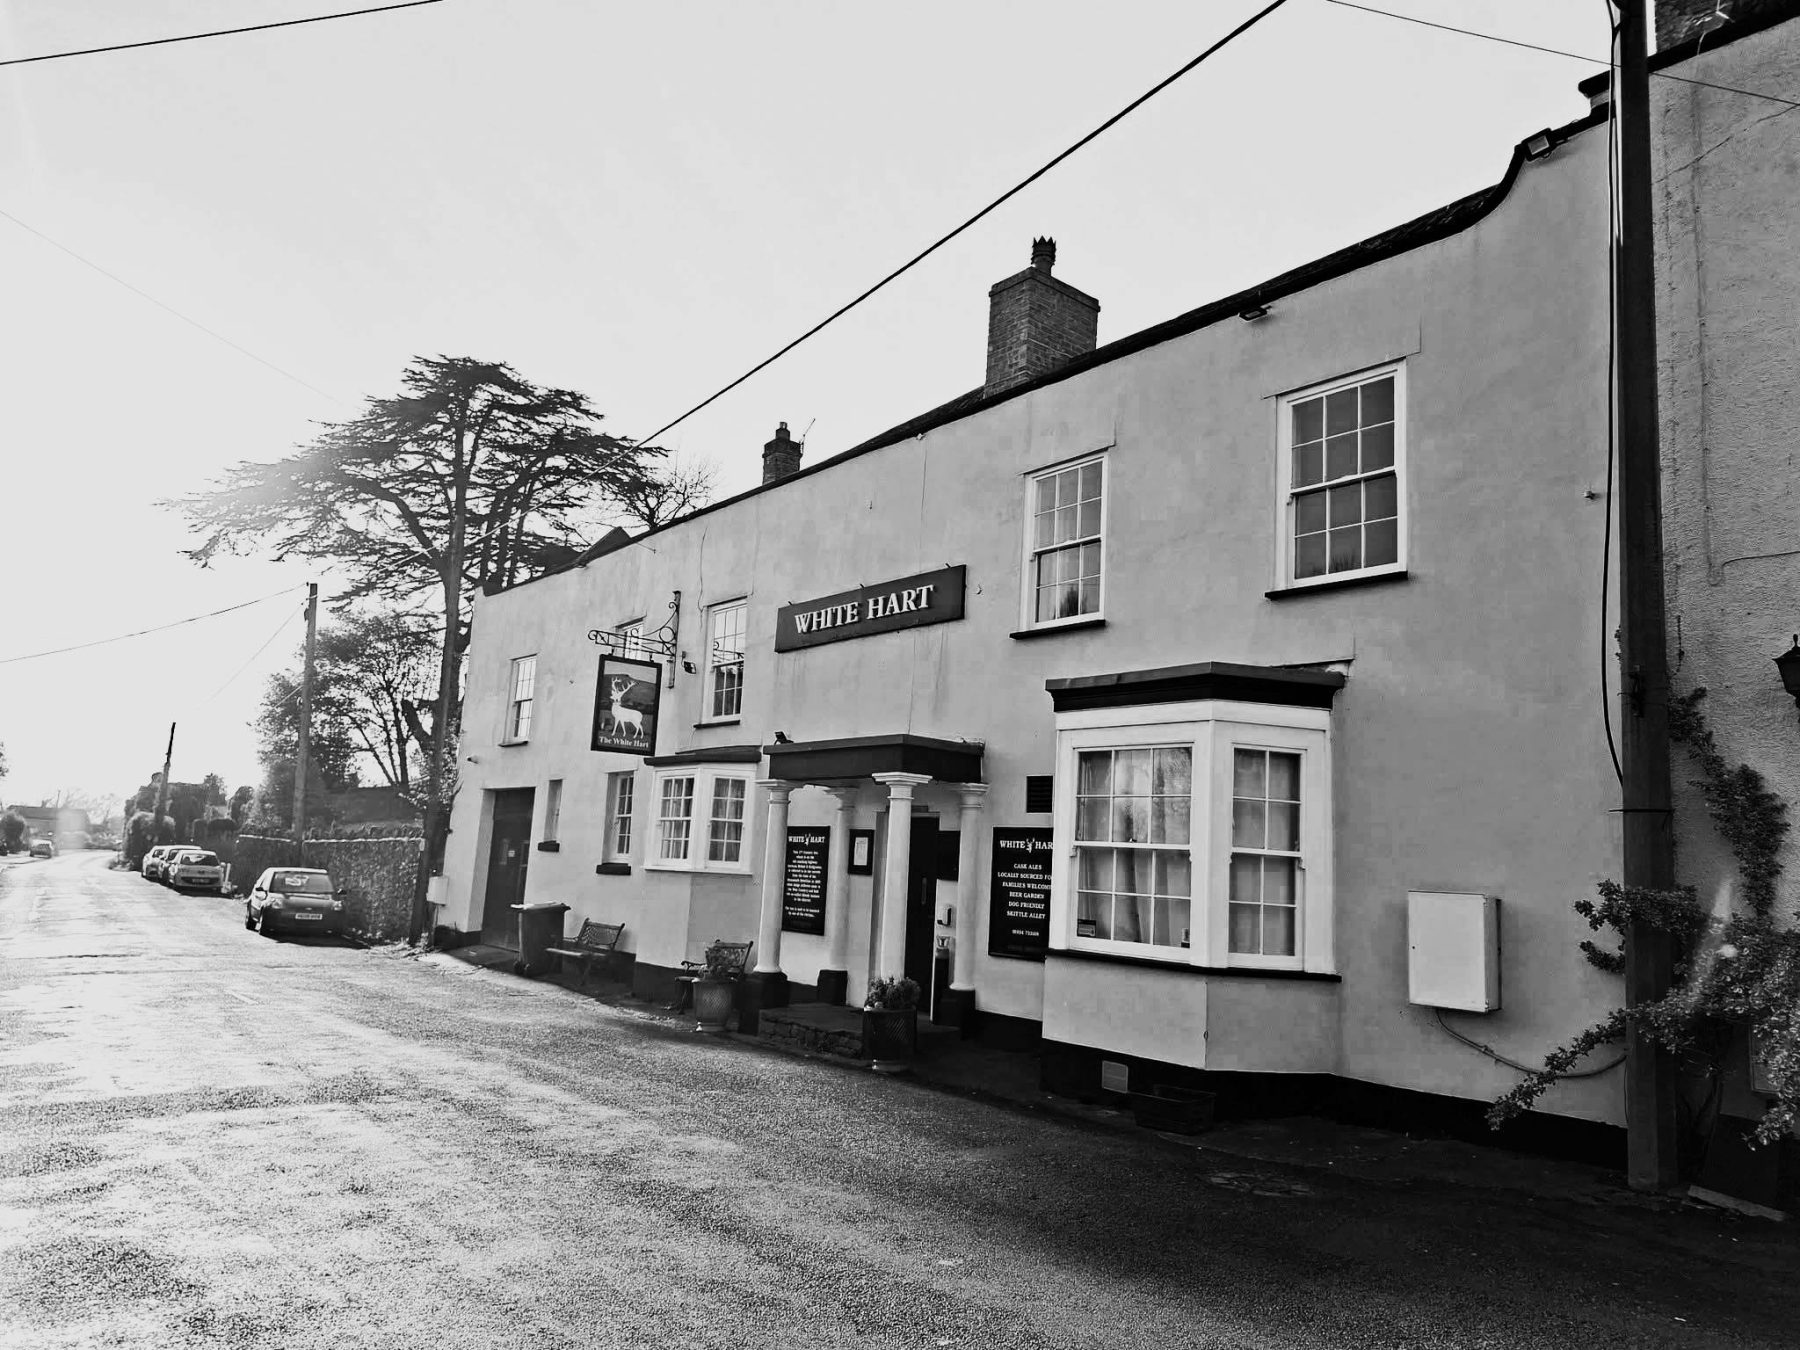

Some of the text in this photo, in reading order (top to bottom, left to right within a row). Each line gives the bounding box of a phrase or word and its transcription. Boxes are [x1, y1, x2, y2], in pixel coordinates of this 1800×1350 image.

[794, 584, 933, 633] WHITE HART
[599, 736, 648, 748] The White Hart
[1000, 840, 1053, 850] WHITE HAR
